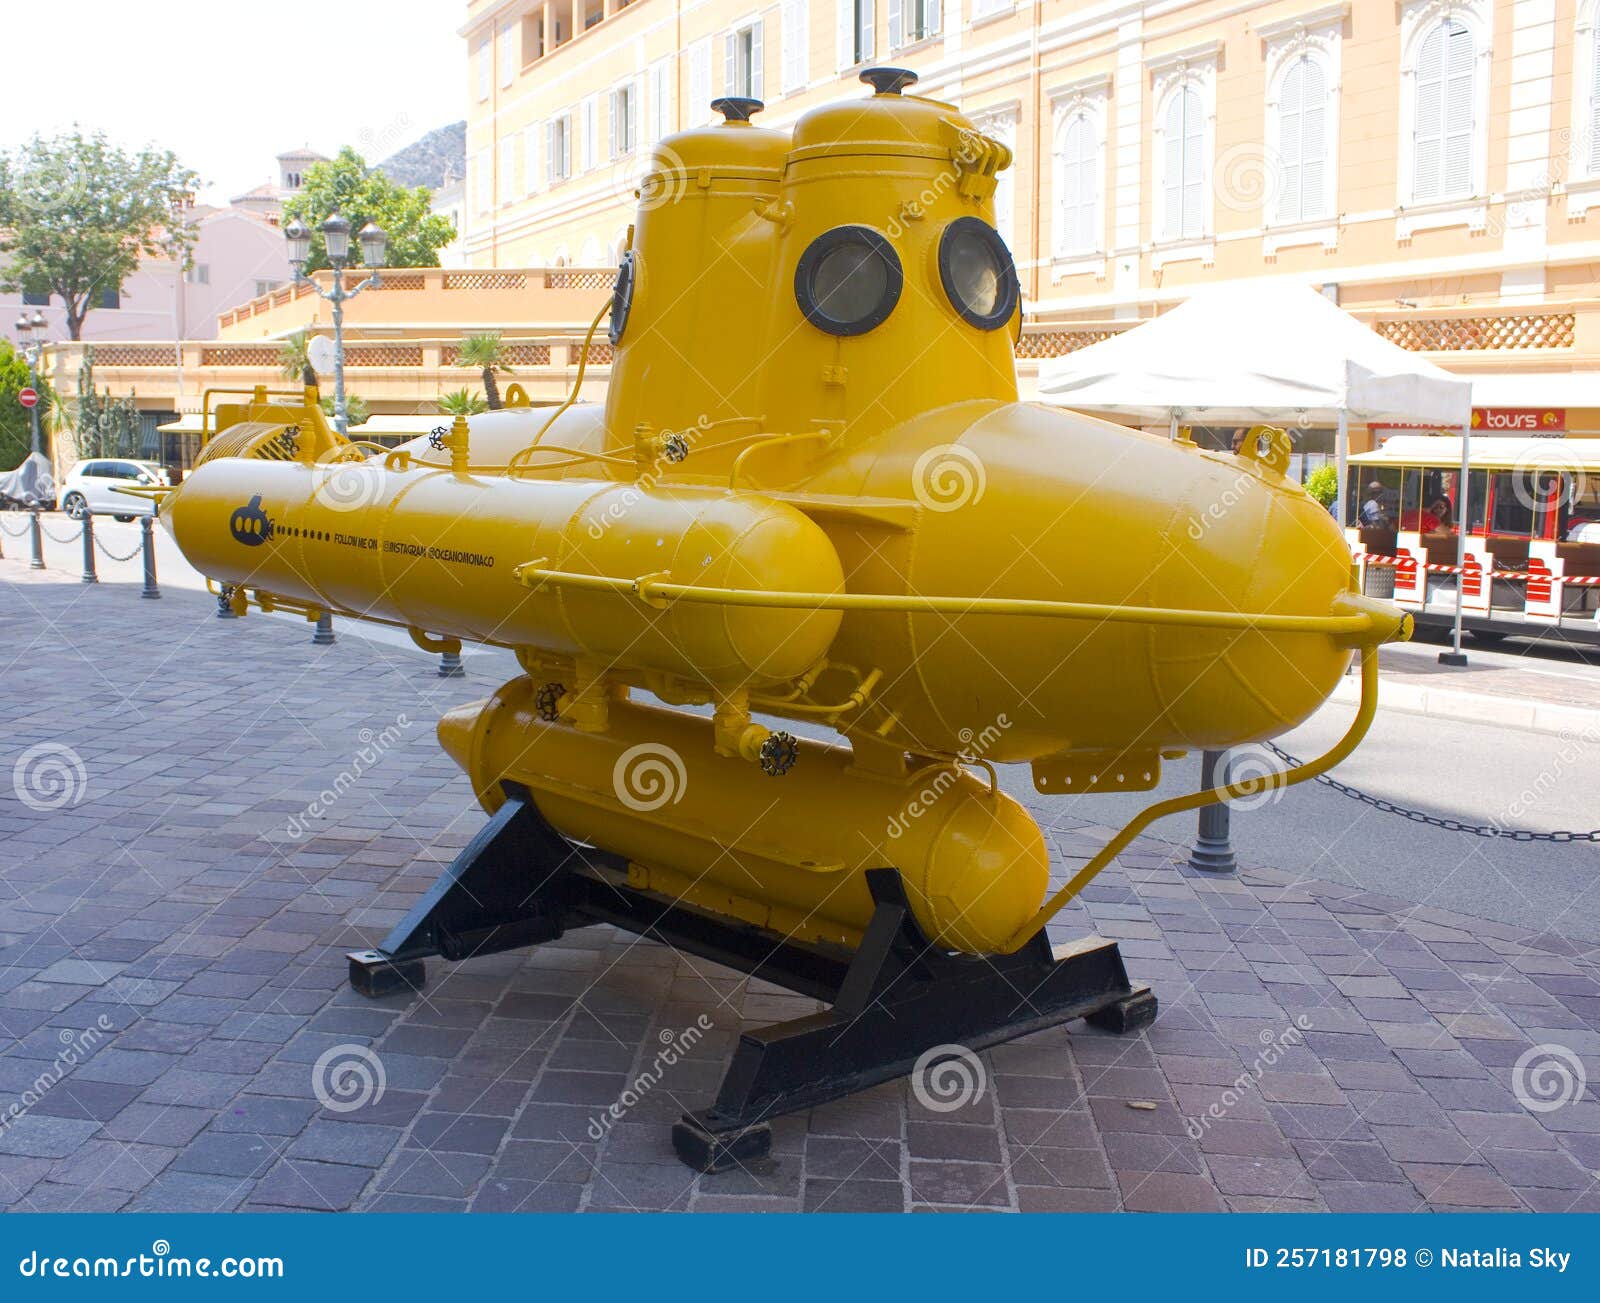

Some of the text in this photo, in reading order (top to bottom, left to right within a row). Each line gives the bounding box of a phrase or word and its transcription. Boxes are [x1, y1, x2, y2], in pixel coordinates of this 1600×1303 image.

[1487, 410, 1537, 428] tours
[334, 533, 357, 547] FOLLOW
[358, 536, 367, 549] ME
[368, 538, 378, 551] ON
